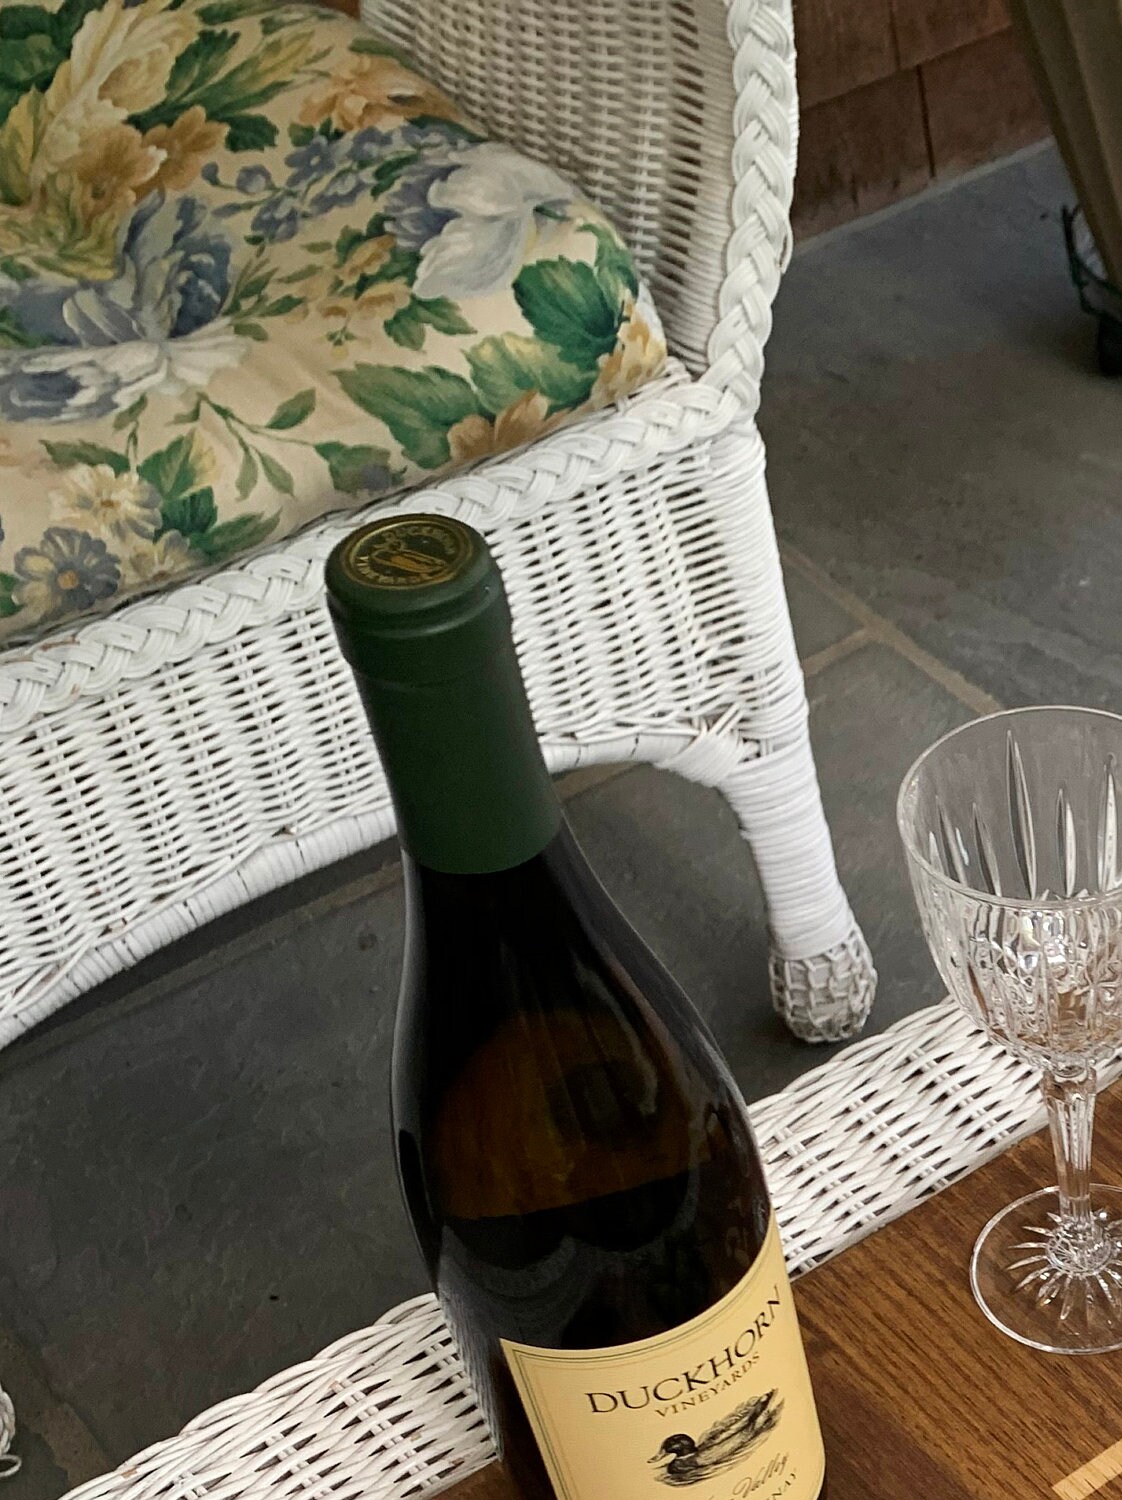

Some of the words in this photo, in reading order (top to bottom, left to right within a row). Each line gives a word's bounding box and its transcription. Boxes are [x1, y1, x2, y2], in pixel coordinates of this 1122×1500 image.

[584, 1283, 781, 1414] DUCKHORN
[654, 1352, 760, 1418] VINEYARDS
[732, 1452, 789, 1499] Valley
